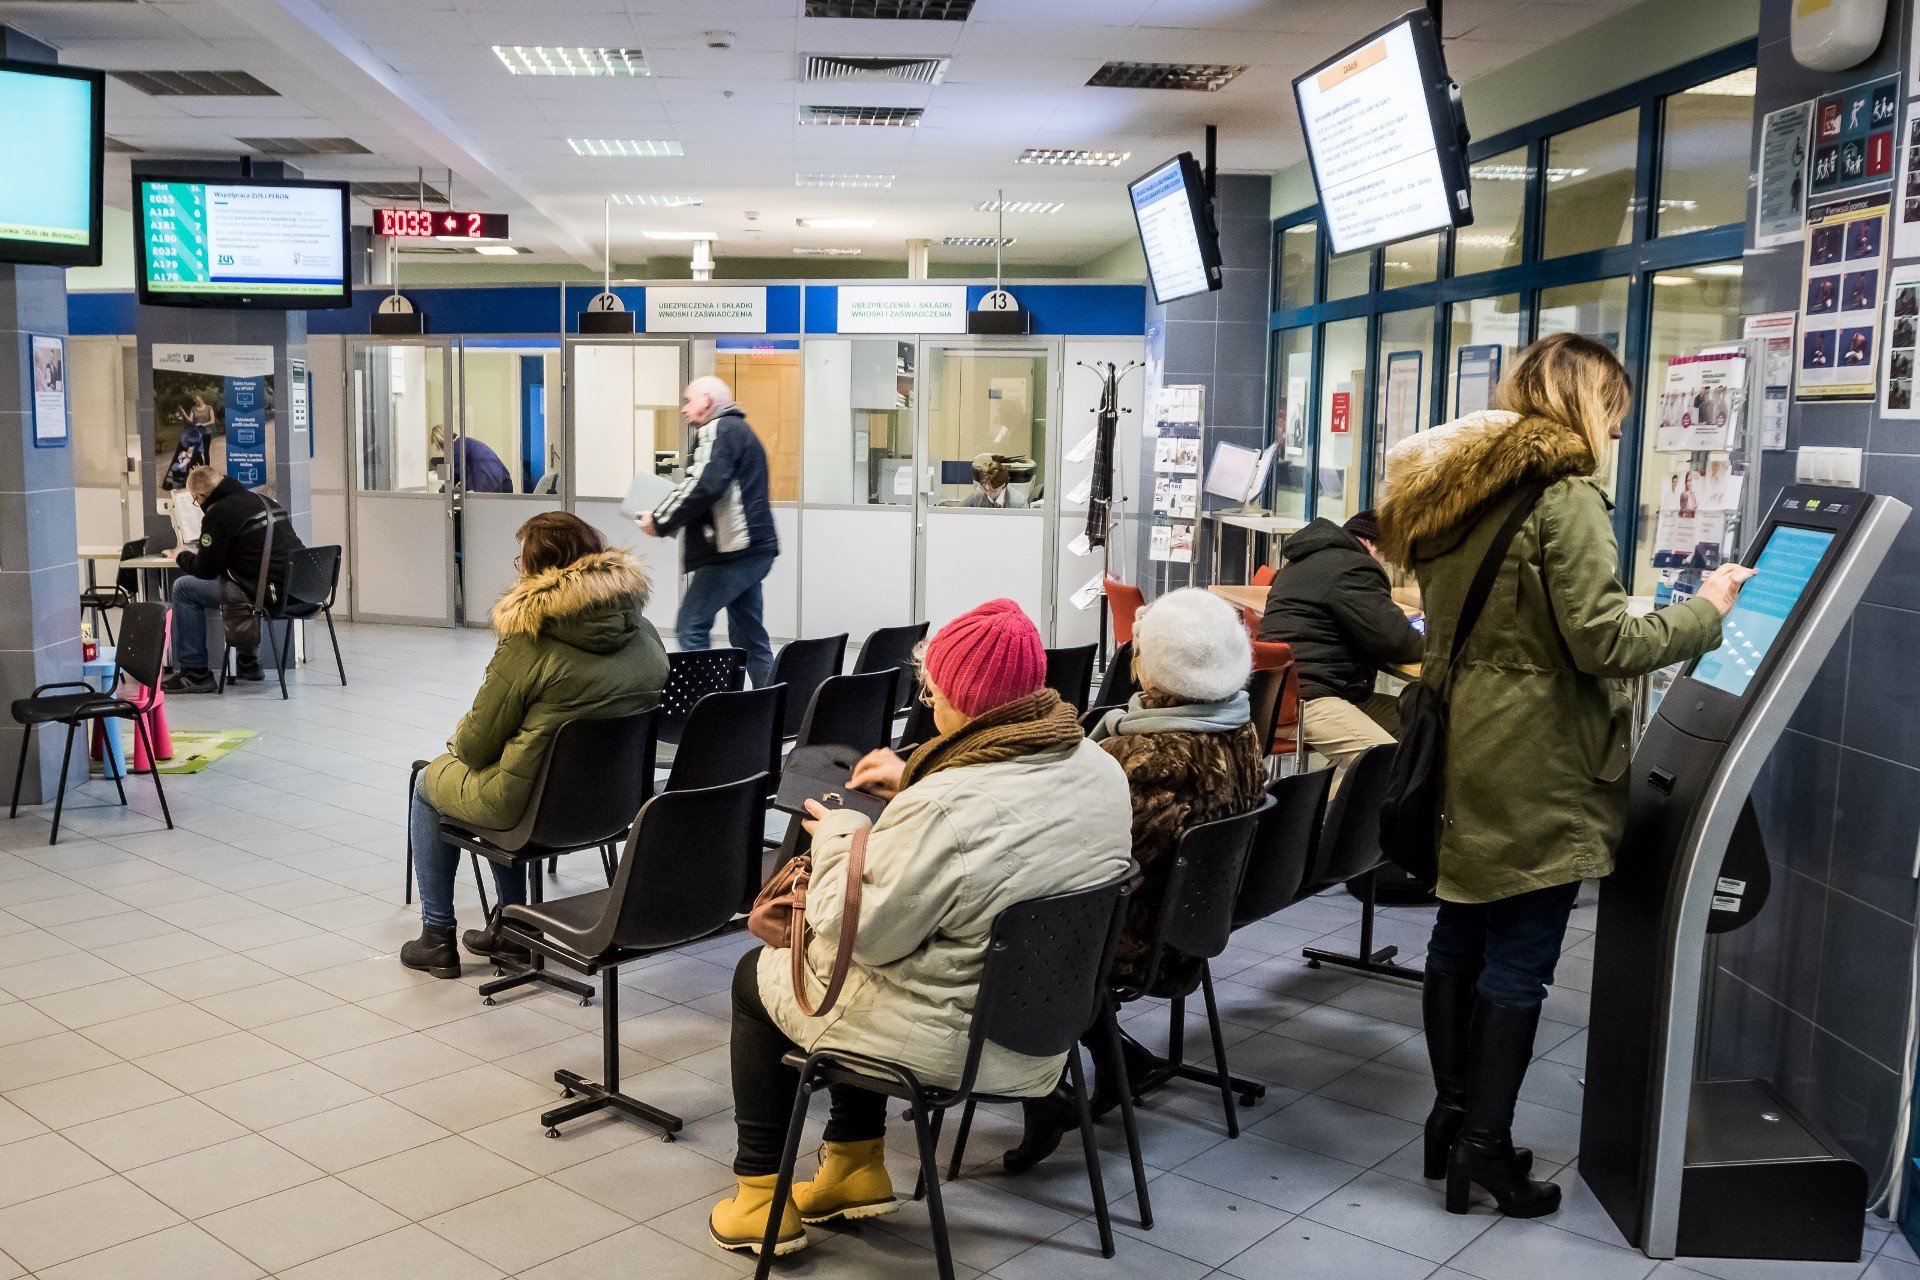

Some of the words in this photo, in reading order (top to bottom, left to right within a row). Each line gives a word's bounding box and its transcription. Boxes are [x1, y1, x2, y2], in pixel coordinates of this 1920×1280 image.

[382, 210, 432, 236] E033
[467, 213, 482, 239] 2
[389, 297, 401, 312] 11
[599, 295, 614, 311] 12
[990, 293, 1007, 310] 13
[694, 309, 753, 318] ZAŚWIADCZENIA
[889, 309, 952, 317] ZAŚWIADCZENIA
